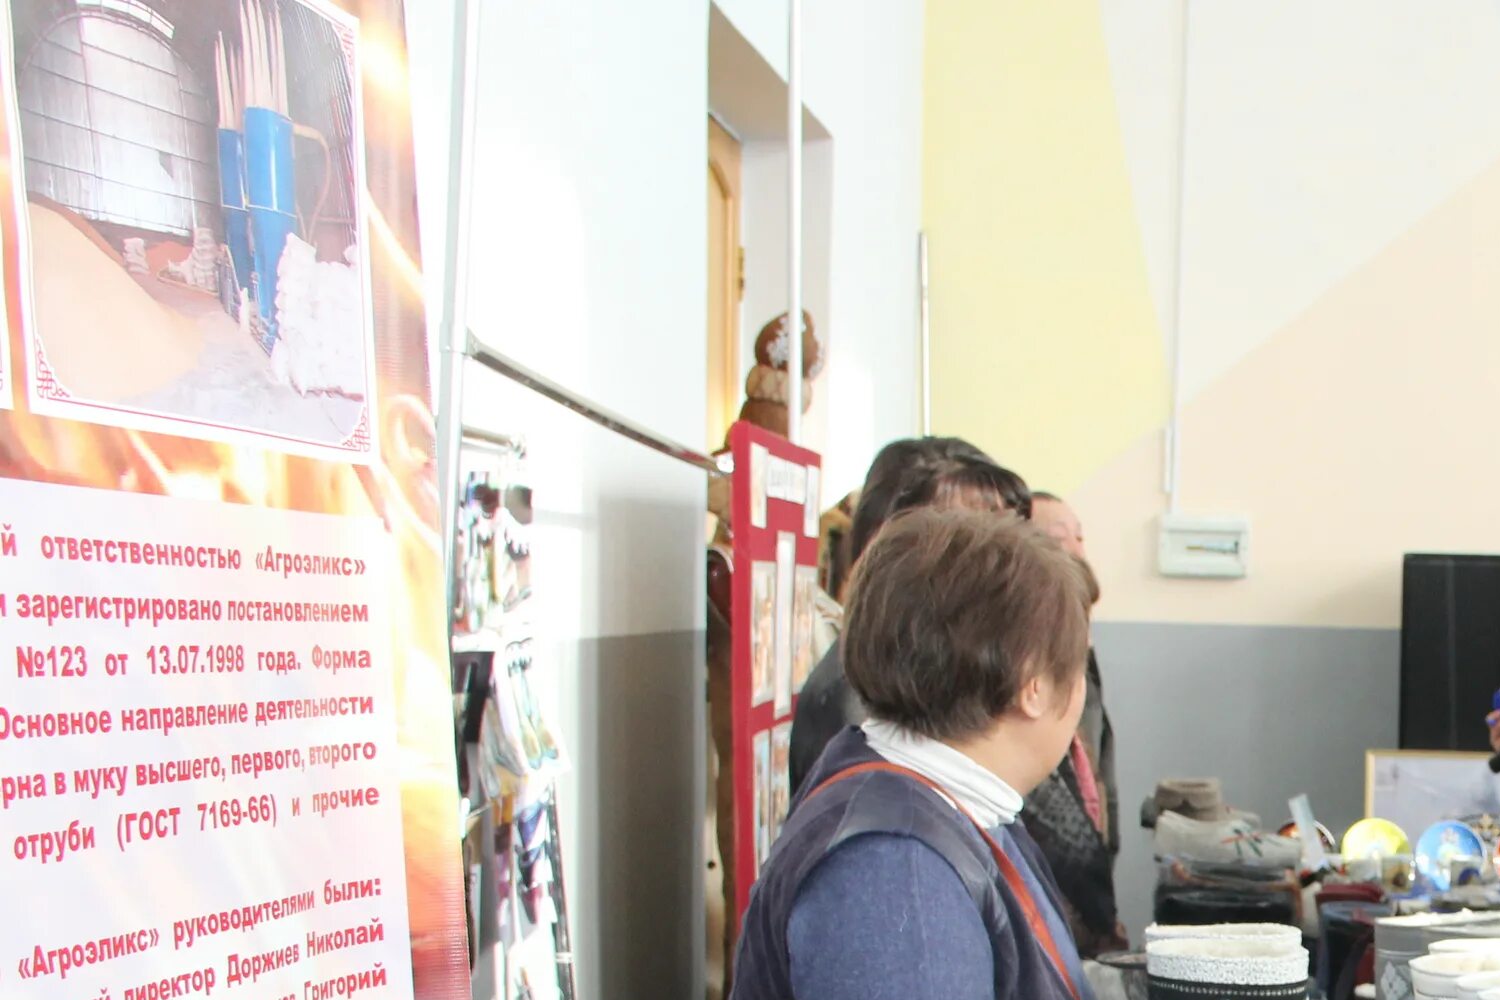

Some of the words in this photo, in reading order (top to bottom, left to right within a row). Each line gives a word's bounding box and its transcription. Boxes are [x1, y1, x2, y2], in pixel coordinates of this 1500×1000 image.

[1, 524, 17, 556] й
[41, 536, 241, 570] ответственностью
[256, 545, 365, 579] «Агроэликс»
[16, 594, 222, 627] зарегистрировано
[228, 601, 368, 622] постановлением
[16, 646, 88, 678] №123
[105, 653, 128, 676] от
[147, 645, 244, 675] 13.07.1998
[258, 651, 301, 675] года.
[312, 645, 371, 675] Форма
[121, 703, 248, 736] направление
[255, 696, 373, 726] деятельности
[1, 774, 47, 809] рна
[54, 772, 67, 795] в
[74, 766, 128, 799] муку
[136, 756, 226, 786] высшего,
[231, 749, 304, 779] первого,
[309, 742, 376, 768] второго
[14, 820, 95, 864] отруби
[117, 807, 181, 852] (ГОСТ
[197, 795, 276, 831] 7169-66)
[292, 798, 300, 816] и
[313, 787, 379, 817] прочие
[18, 928, 159, 979] «Агроэликс»
[173, 891, 314, 950] руководителями
[324, 878, 381, 905] были:
[227, 944, 299, 988] Доржиев
[307, 917, 384, 957] Николай
